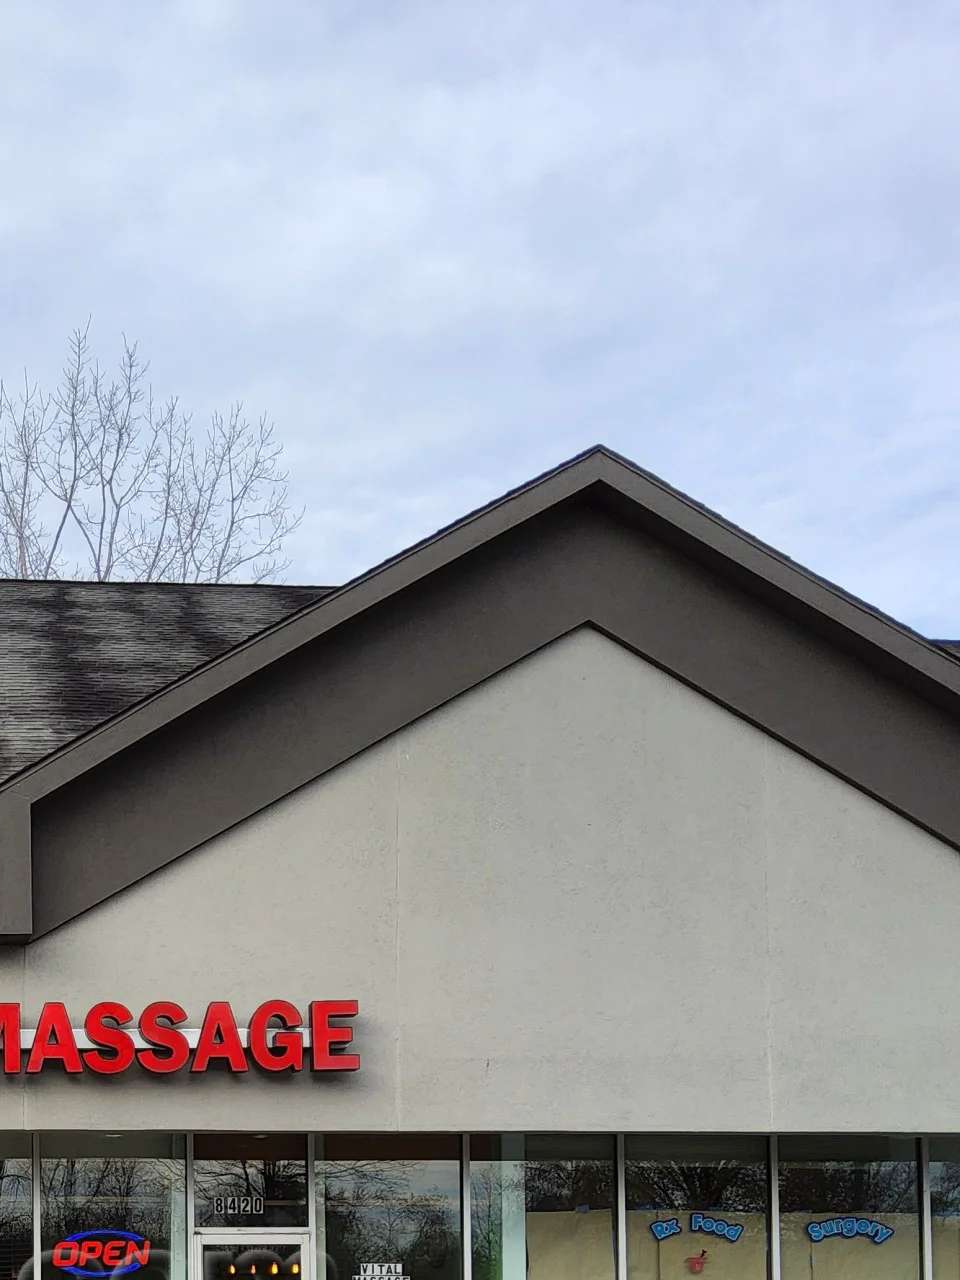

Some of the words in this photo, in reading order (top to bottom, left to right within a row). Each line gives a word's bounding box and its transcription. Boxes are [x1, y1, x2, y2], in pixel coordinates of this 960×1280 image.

[215, 1196, 263, 1214] 8420
[650, 1217, 682, 1241] Rx
[690, 1213, 744, 1243] Food
[806, 1216, 895, 1245] Surgery
[52, 1240, 151, 1267] OPEN
[361, 1264, 402, 1275] VITAL
